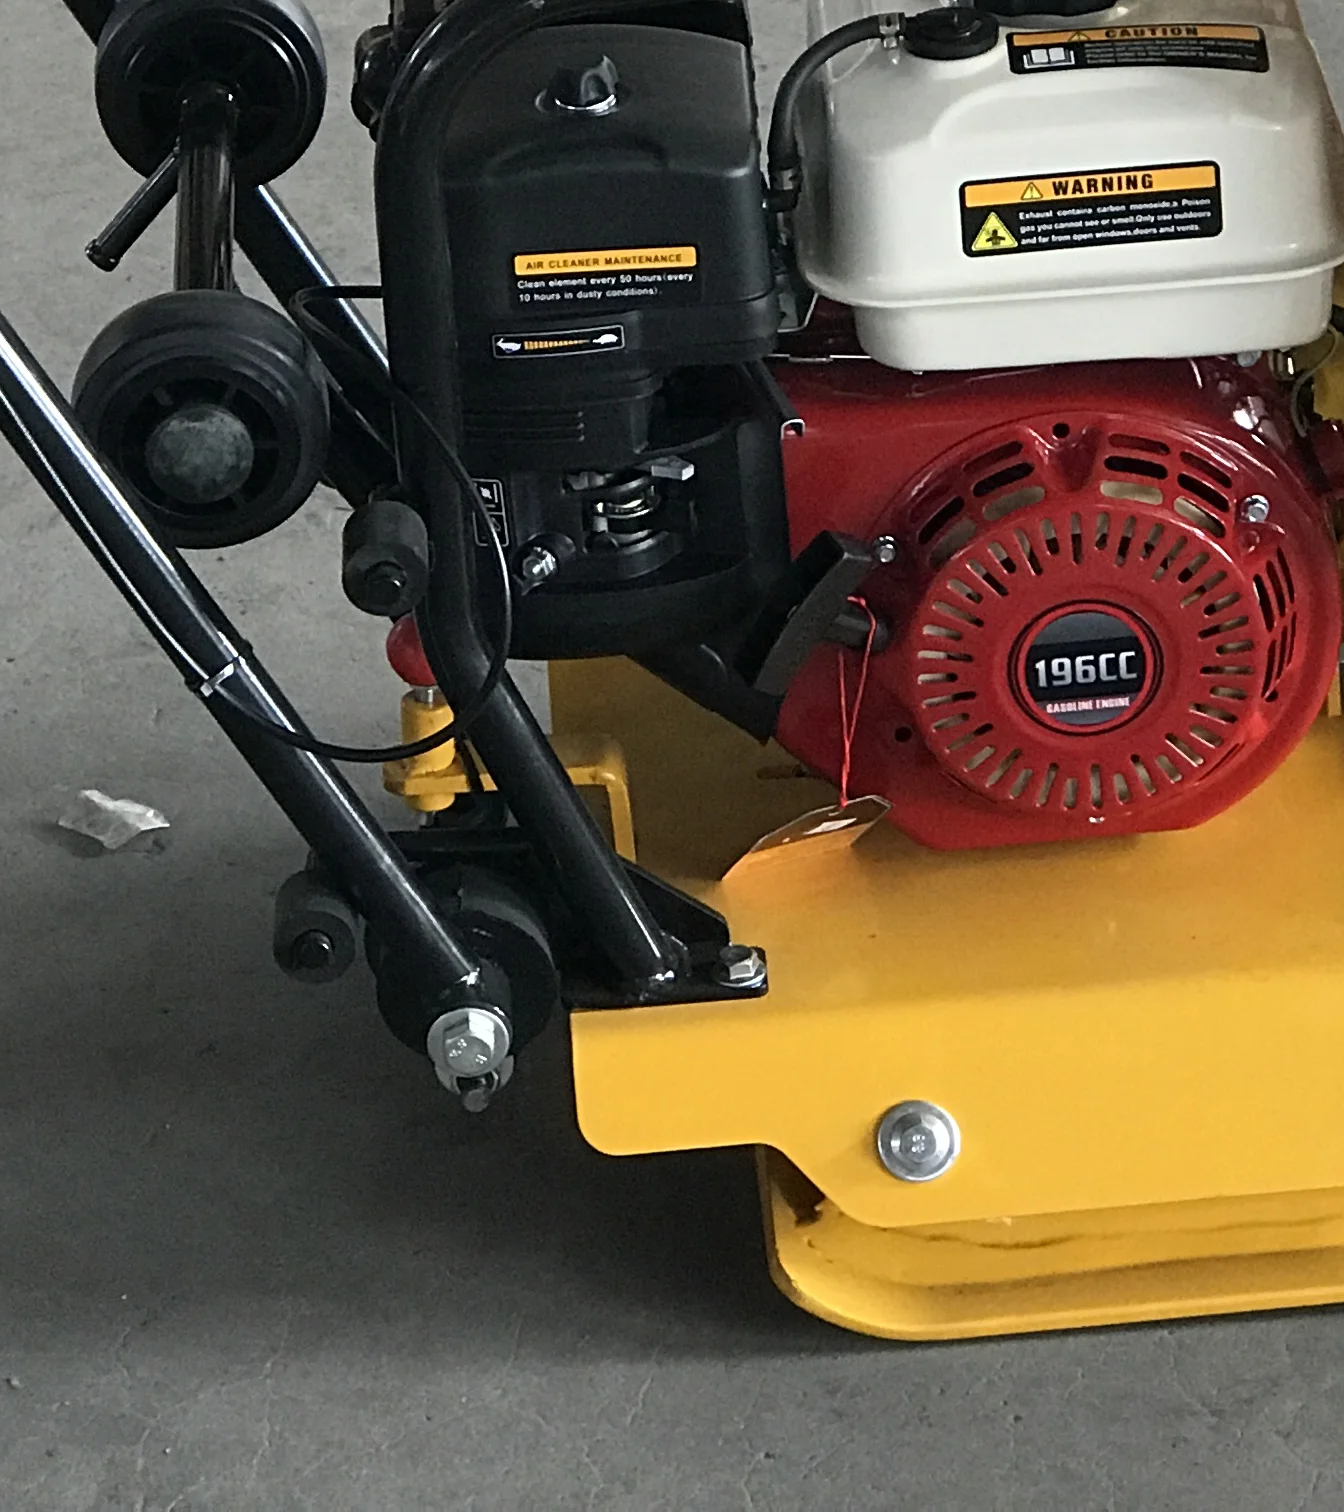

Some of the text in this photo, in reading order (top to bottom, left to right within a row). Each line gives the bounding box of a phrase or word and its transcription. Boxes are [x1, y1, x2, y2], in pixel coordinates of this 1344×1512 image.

[1104, 25, 1199, 39] CAUTION
[1051, 172, 1154, 197] WARNING
[1018, 209, 1054, 220] Exhaust
[1096, 204, 1126, 214] carbon
[1019, 225, 1036, 234] gas
[1036, 223, 1053, 233] you
[1020, 236, 1037, 245] and
[1158, 225, 1175, 234] and
[525, 253, 683, 270] AIR CLEANER MAINTENANCE
[517, 279, 546, 289] Clean
[589, 276, 617, 286] every
[619, 273, 632, 284] 50
[519, 292, 531, 303] 10
[533, 292, 562, 301] hours
[563, 291, 574, 300] in
[1035, 651, 1137, 687] 196CC
